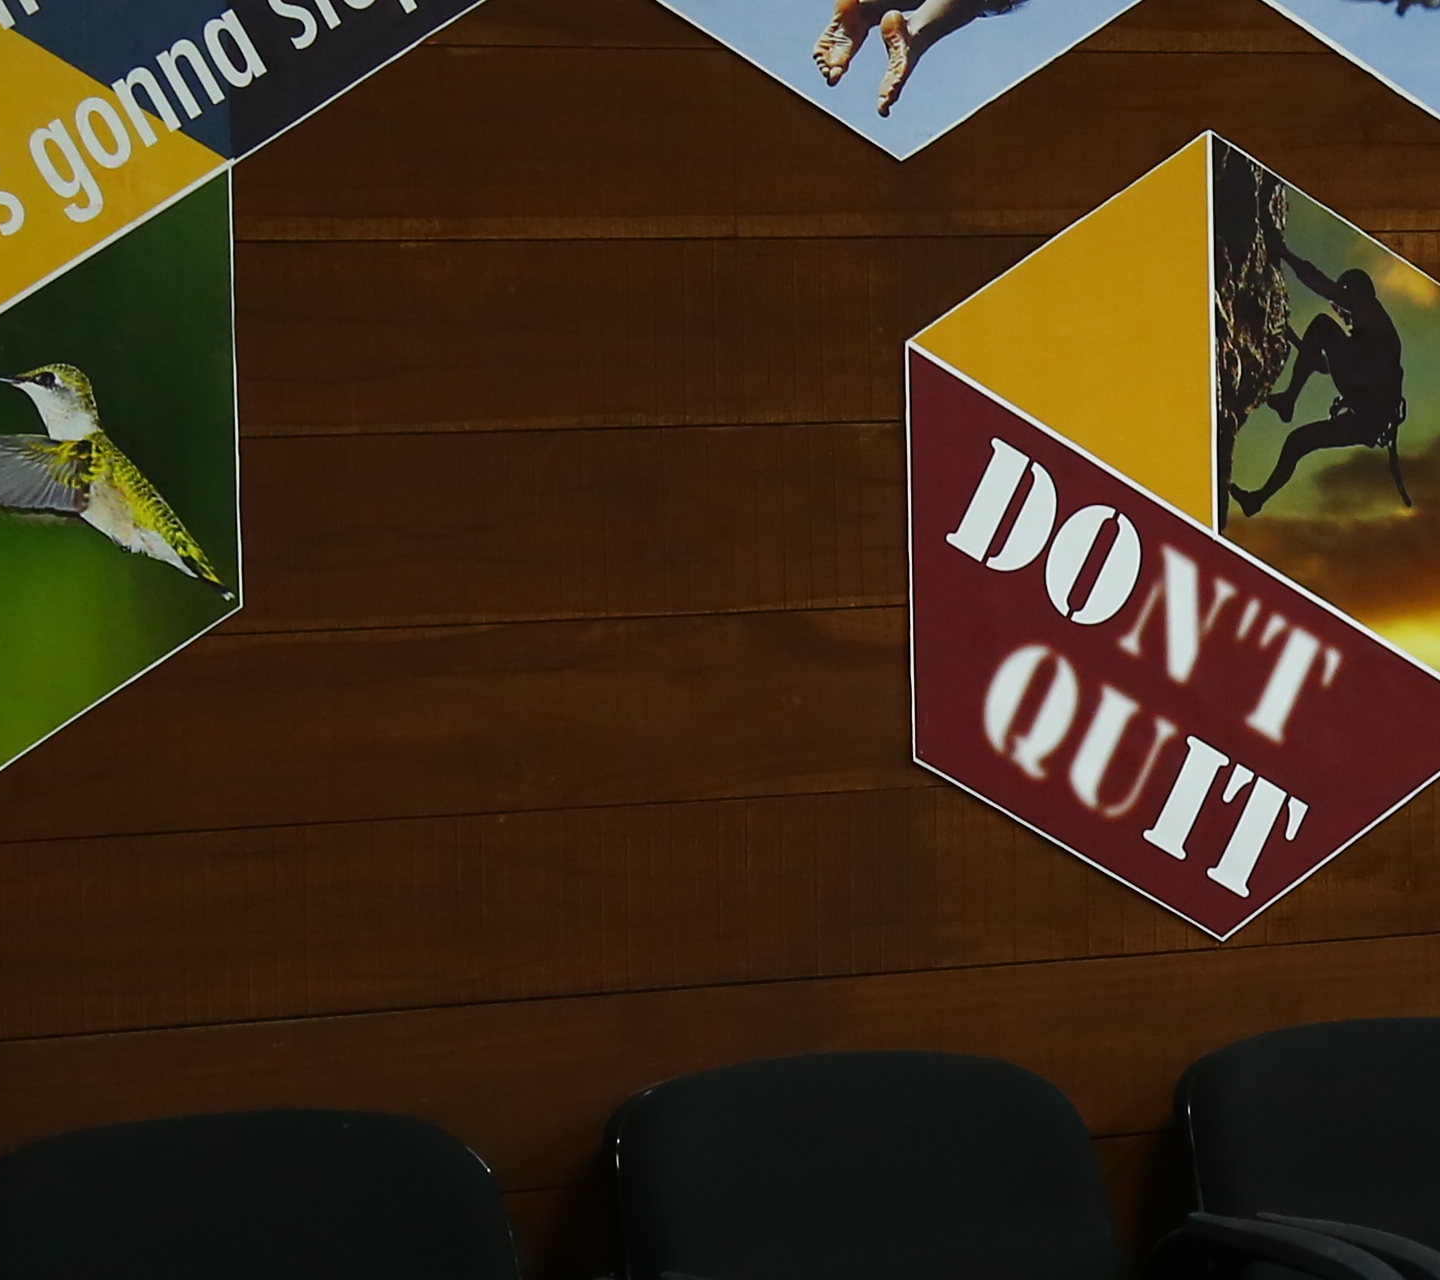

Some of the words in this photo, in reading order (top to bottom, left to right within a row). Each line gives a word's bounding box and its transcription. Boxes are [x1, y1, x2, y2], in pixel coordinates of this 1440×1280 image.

[28, 8, 268, 222] gonna
[945, 437, 1342, 742] DON'T
[982, 642, 1310, 898] QUIT
